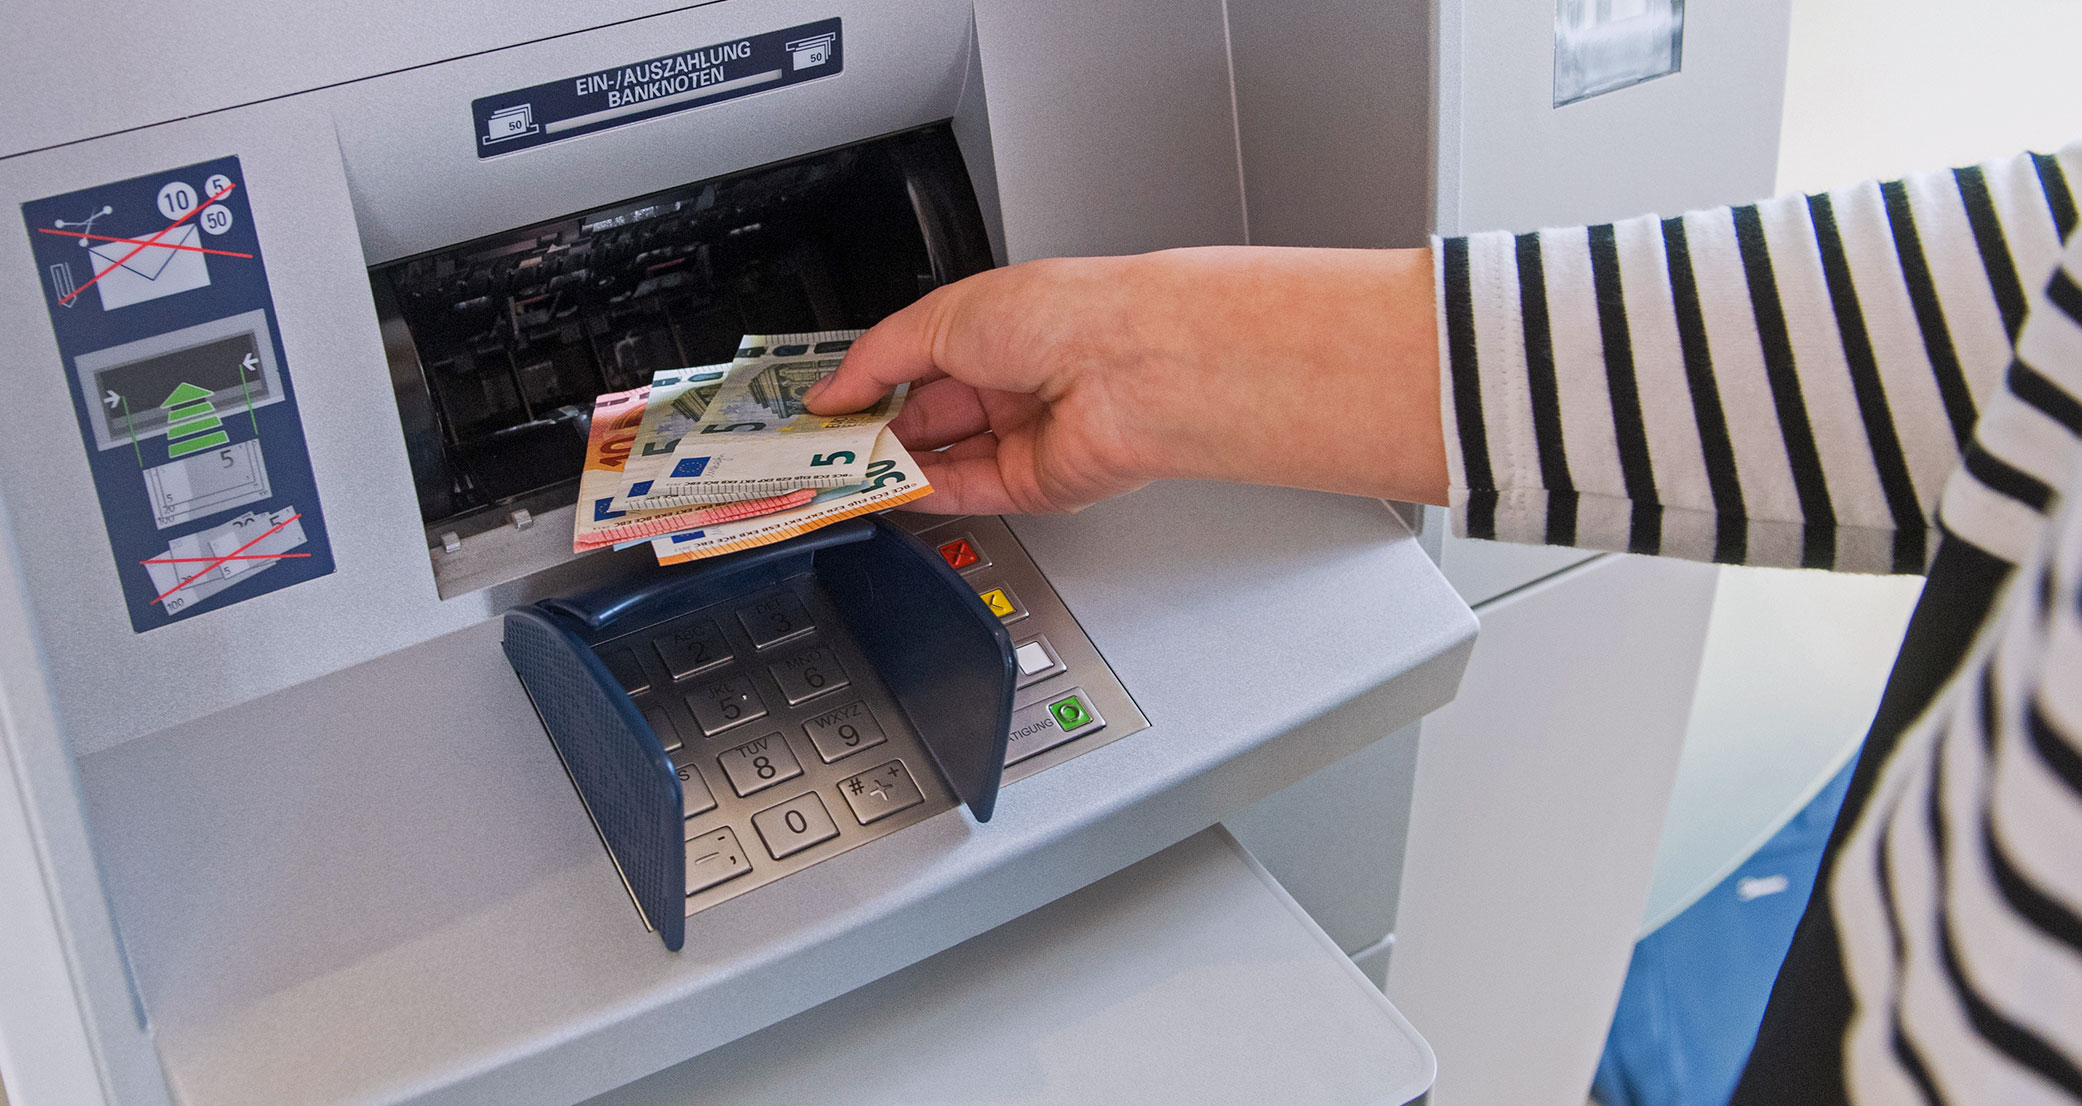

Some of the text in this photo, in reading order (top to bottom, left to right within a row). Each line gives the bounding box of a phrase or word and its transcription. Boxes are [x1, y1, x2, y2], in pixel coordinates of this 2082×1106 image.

[810, 52, 823, 64] 50
[576, 41, 751, 97] EIN-/AUSZAHLUNG
[608, 66, 725, 109] BANKNOTEN
[508, 119, 522, 132] 50
[212, 178, 225, 195] 5
[164, 189, 190, 213] 10
[207, 210, 227, 229] 50
[701, 422, 767, 435] 5
[220, 450, 234, 469] 5
[809, 450, 857, 468] 5
[166, 493, 173, 502] 5
[870, 491, 889, 501] ECB
[804, 511, 824, 520] EKP
[826, 505, 845, 514] EZB
[614, 519, 633, 527] EBC
[739, 529, 759, 538] EKB
[223, 566, 231, 575] 5
[167, 598, 185, 612] 100
[770, 612, 791, 633] 3
[674, 628, 705, 645] ABC
[688, 641, 711, 664] 2
[786, 650, 822, 670] MNO
[804, 666, 825, 689] 6
[708, 683, 735, 699] JKL
[719, 697, 741, 720] 5
[814, 704, 862, 729] WXYZ
[837, 724, 861, 748] 9
[735, 738, 768, 758] TUV
[752, 756, 777, 780] 8
[784, 809, 808, 834] 0
